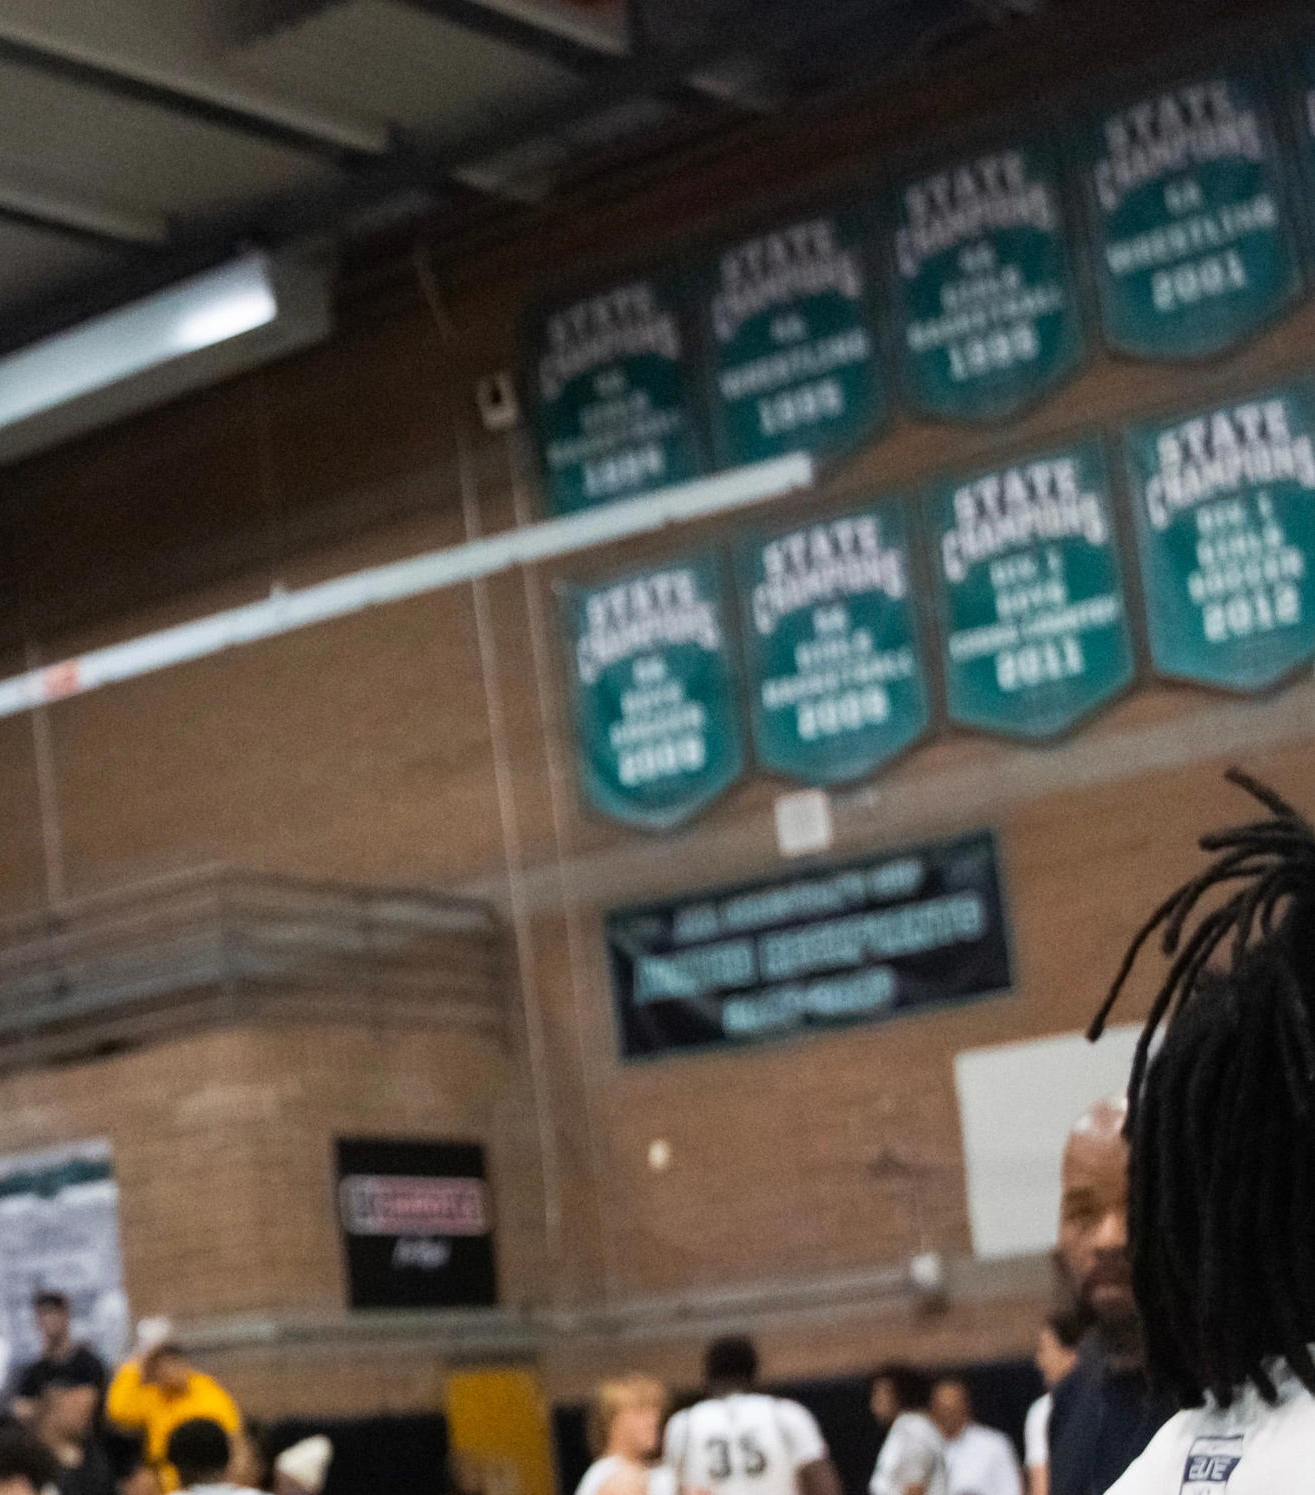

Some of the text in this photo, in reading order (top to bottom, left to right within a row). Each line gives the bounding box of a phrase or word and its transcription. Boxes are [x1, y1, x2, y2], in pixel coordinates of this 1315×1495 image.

[1106, 78, 1229, 152] STATE
[1158, 400, 1289, 475] STATE
[955, 458, 1076, 527] STATE
[763, 514, 880, 583] STATE
[586, 568, 694, 635] STATE
[705, 1431, 767, 1479] 35
